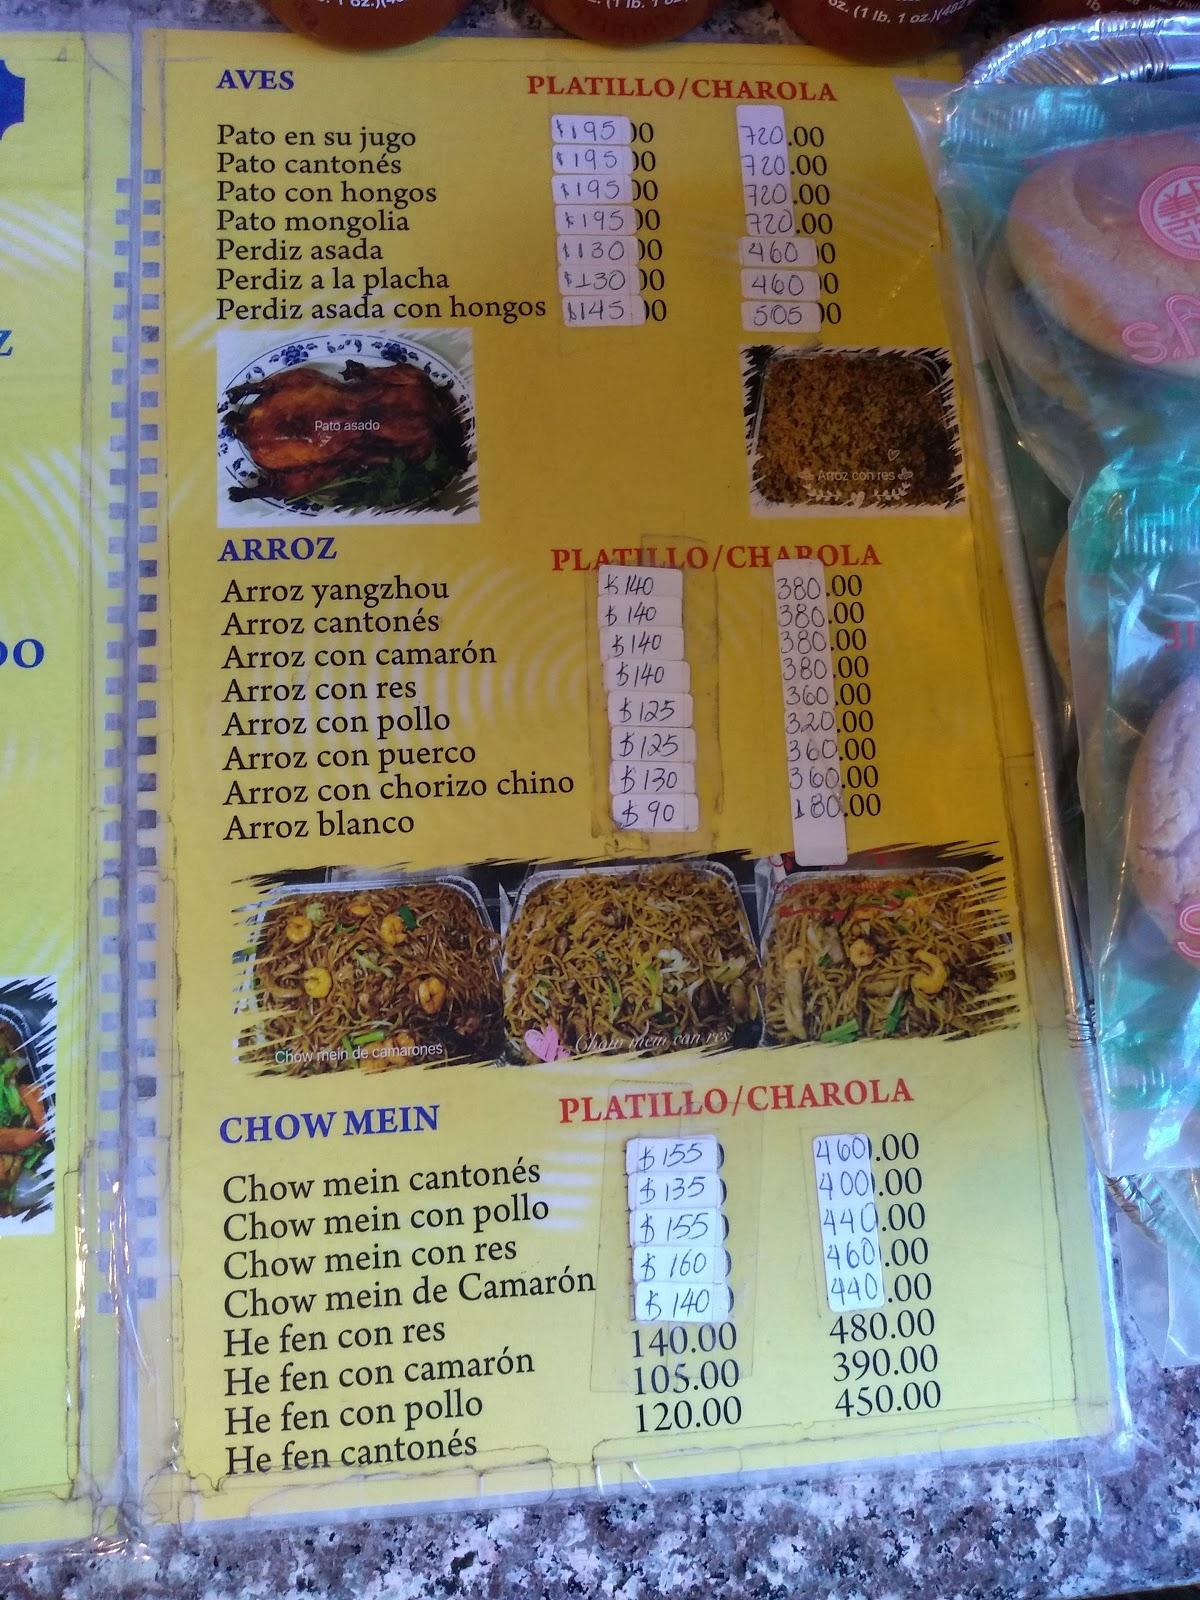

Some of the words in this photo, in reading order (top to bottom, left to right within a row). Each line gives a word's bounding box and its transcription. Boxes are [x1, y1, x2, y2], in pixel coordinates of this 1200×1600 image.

[872, 10, 891, 23] lb.
[898, 13, 906, 24] 1
[216, 69, 295, 91] AVES
[526, 75, 839, 102] PLATILLO/CHAROLA
[217, 124, 276, 146] Pato
[285, 129, 315, 146] en
[324, 130, 351, 146] su
[360, 127, 416, 153] jugo
[556, 119, 616, 140] $195
[217, 152, 276, 174] Pato
[285, 155, 402, 174] cantonés
[557, 149, 618, 169] $195
[217, 180, 276, 202] Pato
[285, 185, 333, 202] con
[340, 181, 437, 209] hongos
[560, 179, 620, 199] $195
[217, 209, 276, 231] Pato
[285, 210, 410, 237] mongolia
[565, 210, 624, 229] $195
[216, 238, 303, 260] Perdiz
[311, 239, 383, 260] asada
[562, 241, 625, 261] $130
[748, 242, 799, 264] 460
[216, 267, 303, 290] Perdiz
[311, 275, 325, 289] a
[333, 267, 356, 289] la
[363, 267, 450, 295] placha
[564, 270, 626, 290] $130
[751, 272, 804, 296] 460
[216, 297, 303, 320] Perdiz
[311, 296, 385, 319] asada
[393, 302, 442, 318] con
[450, 295, 546, 323] hongos
[567, 300, 625, 322] $145
[752, 304, 803, 326] 505
[314, 420, 341, 431] Pato
[344, 419, 381, 432] asado
[818, 470, 849, 481] Arroz
[852, 471, 875, 481] con
[877, 471, 896, 481] res
[217, 537, 338, 562] ARROZ
[552, 544, 883, 572] PLATILLO/CHAROLA
[221, 578, 304, 603] Arroz
[312, 575, 450, 607] yangzhou
[221, 612, 305, 636] Arroz
[313, 608, 440, 633] cantonés
[221, 645, 305, 669] Arroz
[314, 648, 366, 667] con
[375, 640, 497, 665] camarón
[221, 678, 306, 702] Arroz
[315, 681, 368, 700] con
[376, 680, 417, 699] res
[222, 712, 307, 736] Arroz
[316, 714, 369, 733] con
[377, 706, 451, 740] pollo
[222, 746, 307, 771] Arroz
[317, 749, 369, 768] con
[378, 745, 476, 773] puerco
[222, 780, 309, 805] Arroz
[318, 783, 370, 802] con
[380, 774, 487, 799] chorizo
[497, 770, 574, 795] chino
[223, 815, 309, 840] Arroz
[317, 810, 415, 836] blanco
[275, 1047, 313, 1064] Chow
[317, 1047, 348, 1061] mein
[353, 1045, 369, 1060] de
[372, 1042, 443, 1057] camarones
[559, 1077, 914, 1124] PLATILLO/CHAROLA
[220, 1111, 337, 1144] CHOW
[343, 1104, 440, 1137] MEIN
[223, 1173, 314, 1204] Chow
[323, 1168, 400, 1197] mein
[409, 1157, 540, 1192] cantonés
[223, 1211, 315, 1242] Chow
[324, 1205, 400, 1235] mein
[410, 1205, 464, 1229] con
[473, 1192, 549, 1234] pollo
[223, 1249, 315, 1280] Chow
[324, 1243, 401, 1274] mein
[411, 1243, 465, 1266] con
[474, 1239, 517, 1262] res
[224, 1288, 316, 1319] Chow
[325, 1280, 402, 1312] mein
[412, 1276, 448, 1304] de
[458, 1266, 596, 1302] Camarón
[224, 1328, 270, 1358] He
[279, 1323, 328, 1354] fen
[338, 1325, 393, 1348] con
[402, 1321, 446, 1344] res
[632, 1321, 737, 1358] 140.00
[829, 1308, 935, 1344] 480.00
[224, 1366, 270, 1397] He
[280, 1361, 329, 1392] fen
[338, 1364, 394, 1387] con
[404, 1347, 535, 1382] camarón
[833, 1344, 938, 1381] 390.00
[634, 1359, 740, 1395] 105.00
[225, 1406, 271, 1436] He
[281, 1401, 329, 1432] fen
[340, 1403, 395, 1426] con
[404, 1389, 483, 1431] pollo
[835, 1380, 941, 1417] 450.00
[636, 1396, 742, 1433] 120.00
[225, 1445, 272, 1476] He
[281, 1440, 330, 1471] fen
[340, 1429, 477, 1465] cantonés
